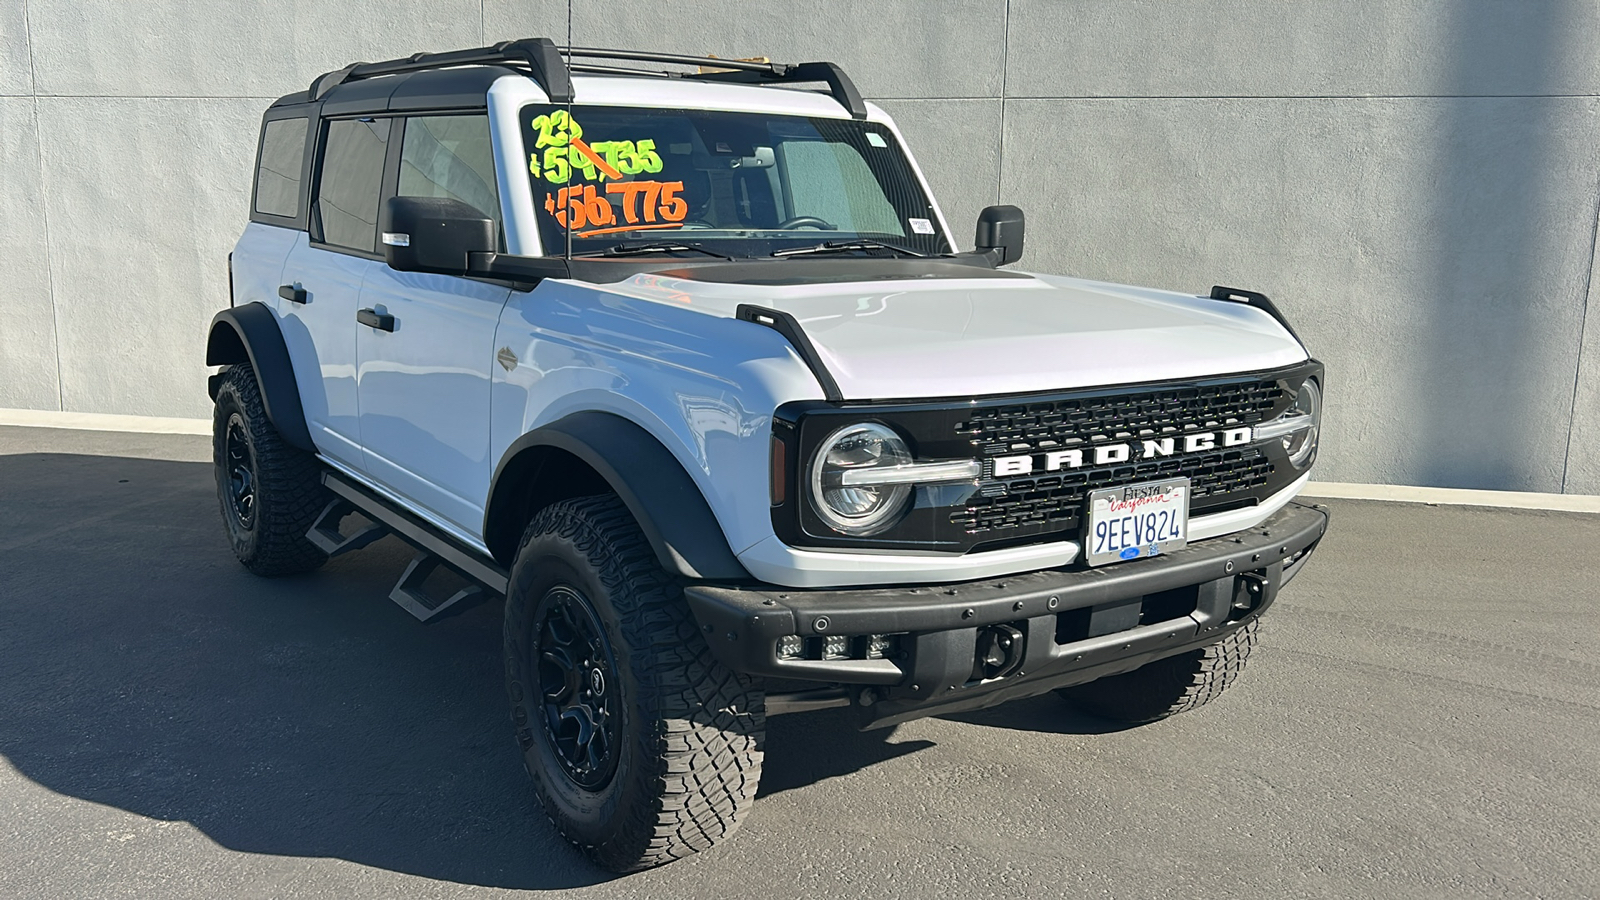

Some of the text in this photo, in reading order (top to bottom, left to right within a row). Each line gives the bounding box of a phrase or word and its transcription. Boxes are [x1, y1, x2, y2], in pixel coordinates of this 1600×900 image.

[531, 109, 583, 149] 23
[992, 427, 1253, 477] BRONCO
[1110, 494, 1170, 513] California
[1094, 508, 1180, 554] 9EEV824
